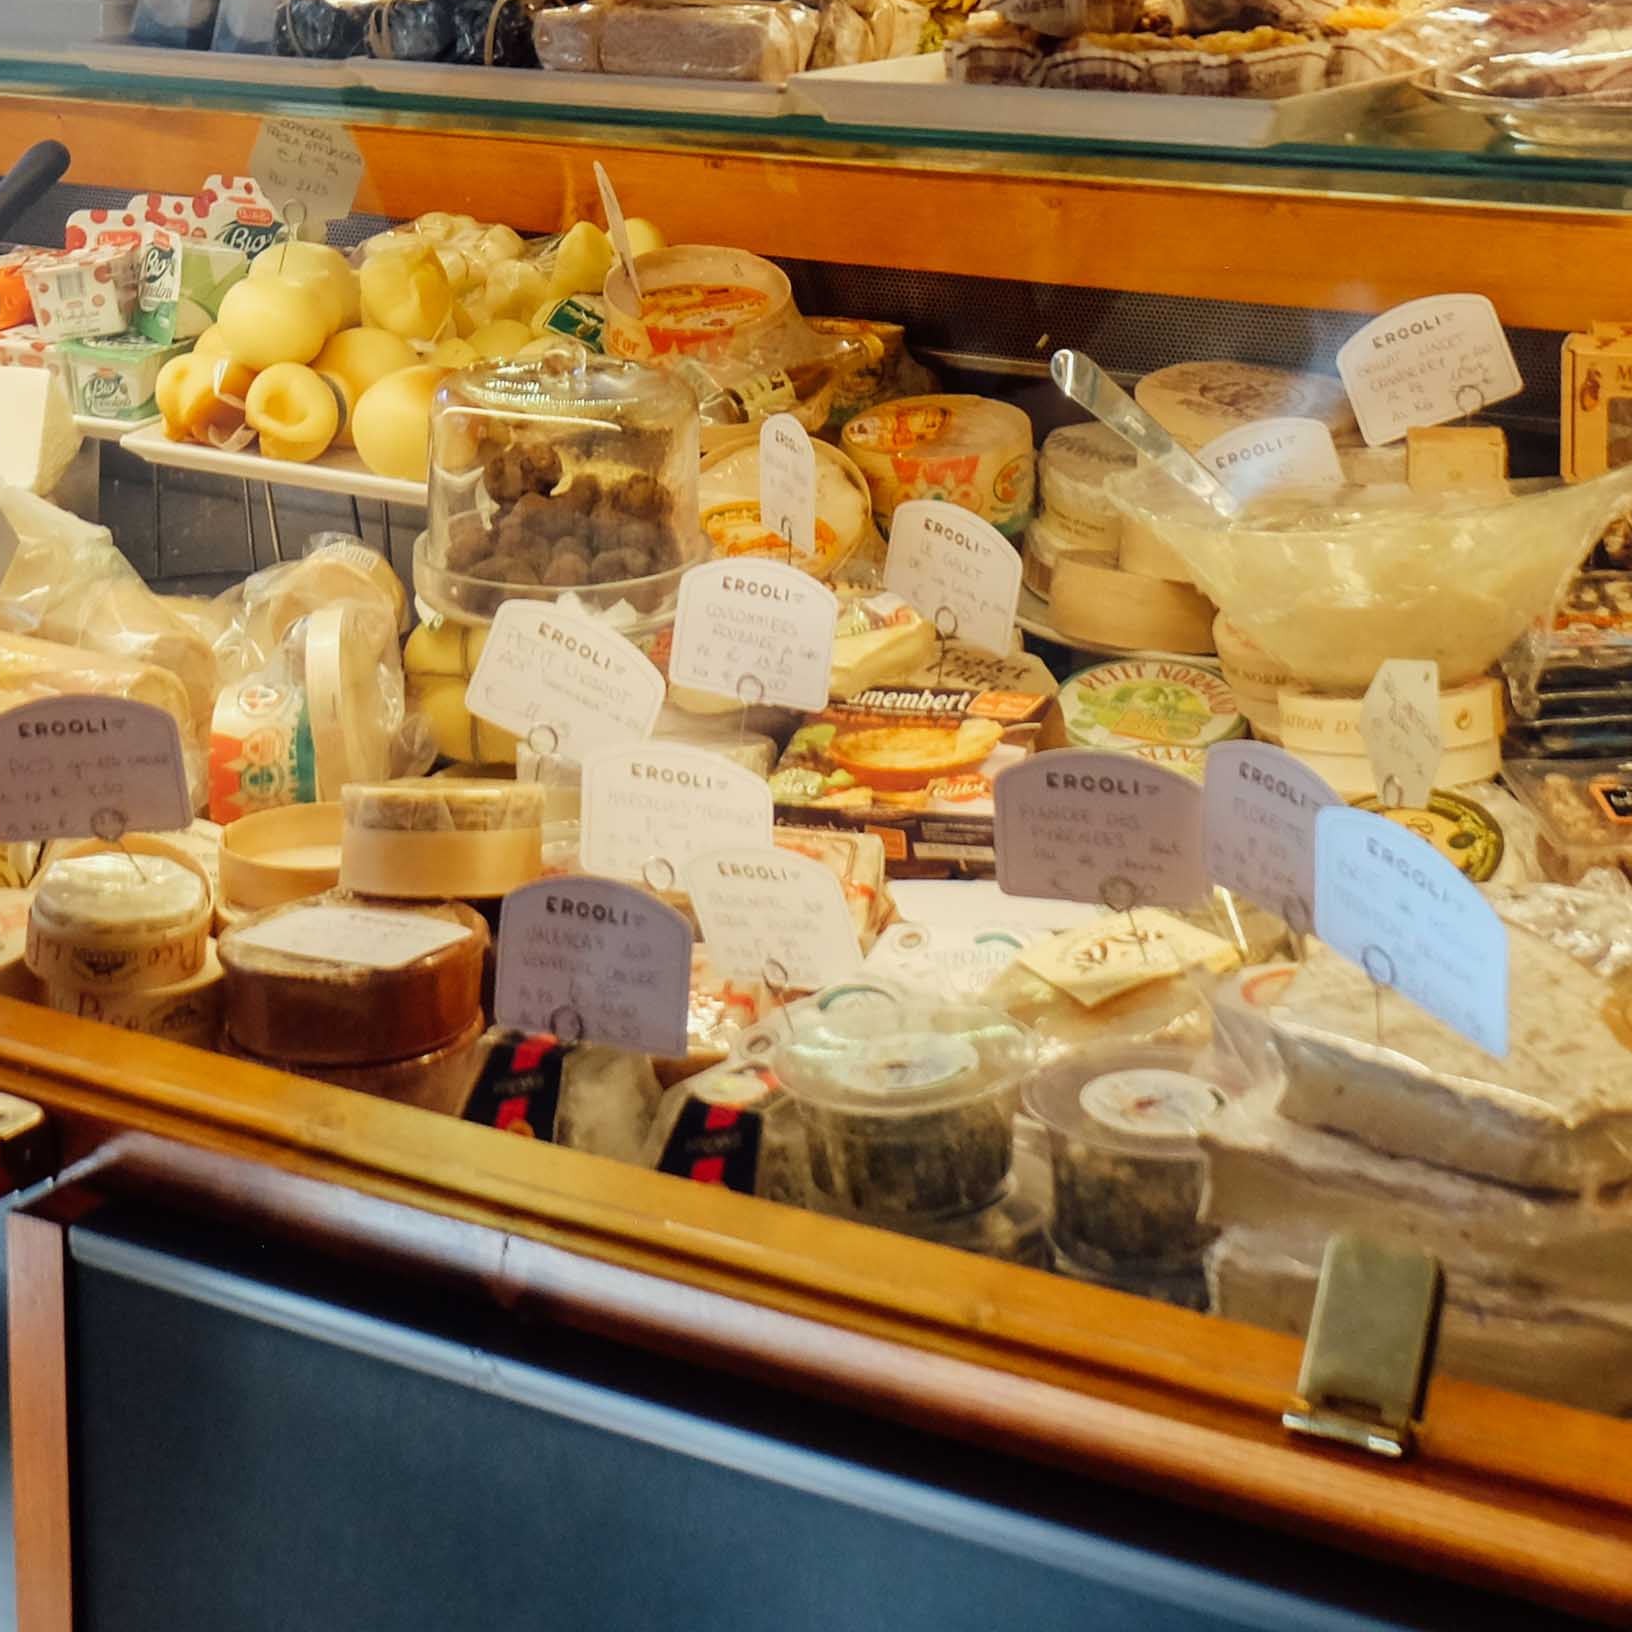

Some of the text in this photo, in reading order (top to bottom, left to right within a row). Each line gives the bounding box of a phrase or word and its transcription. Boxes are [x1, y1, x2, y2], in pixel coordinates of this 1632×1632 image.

[1371, 314, 1442, 351] ERCOLI
[1216, 435, 1284, 470] ERCOLI
[924, 516, 980, 554] ERCOLI
[721, 574, 790, 603] ERCOLI
[537, 619, 613, 672] ERCOLI
[1077, 662, 1146, 691] PETIT
[848, 687, 972, 713] membert
[18, 717, 109, 740] ERCOLI
[630, 761, 713, 790] ERCOLI
[1045, 771, 1142, 798] ERCOLI
[1239, 760, 1307, 809] ERCOLI
[716, 859, 790, 882] ERCOLI
[1366, 836, 1452, 905] ERCOLI
[545, 894, 631, 928] ERCOLI
